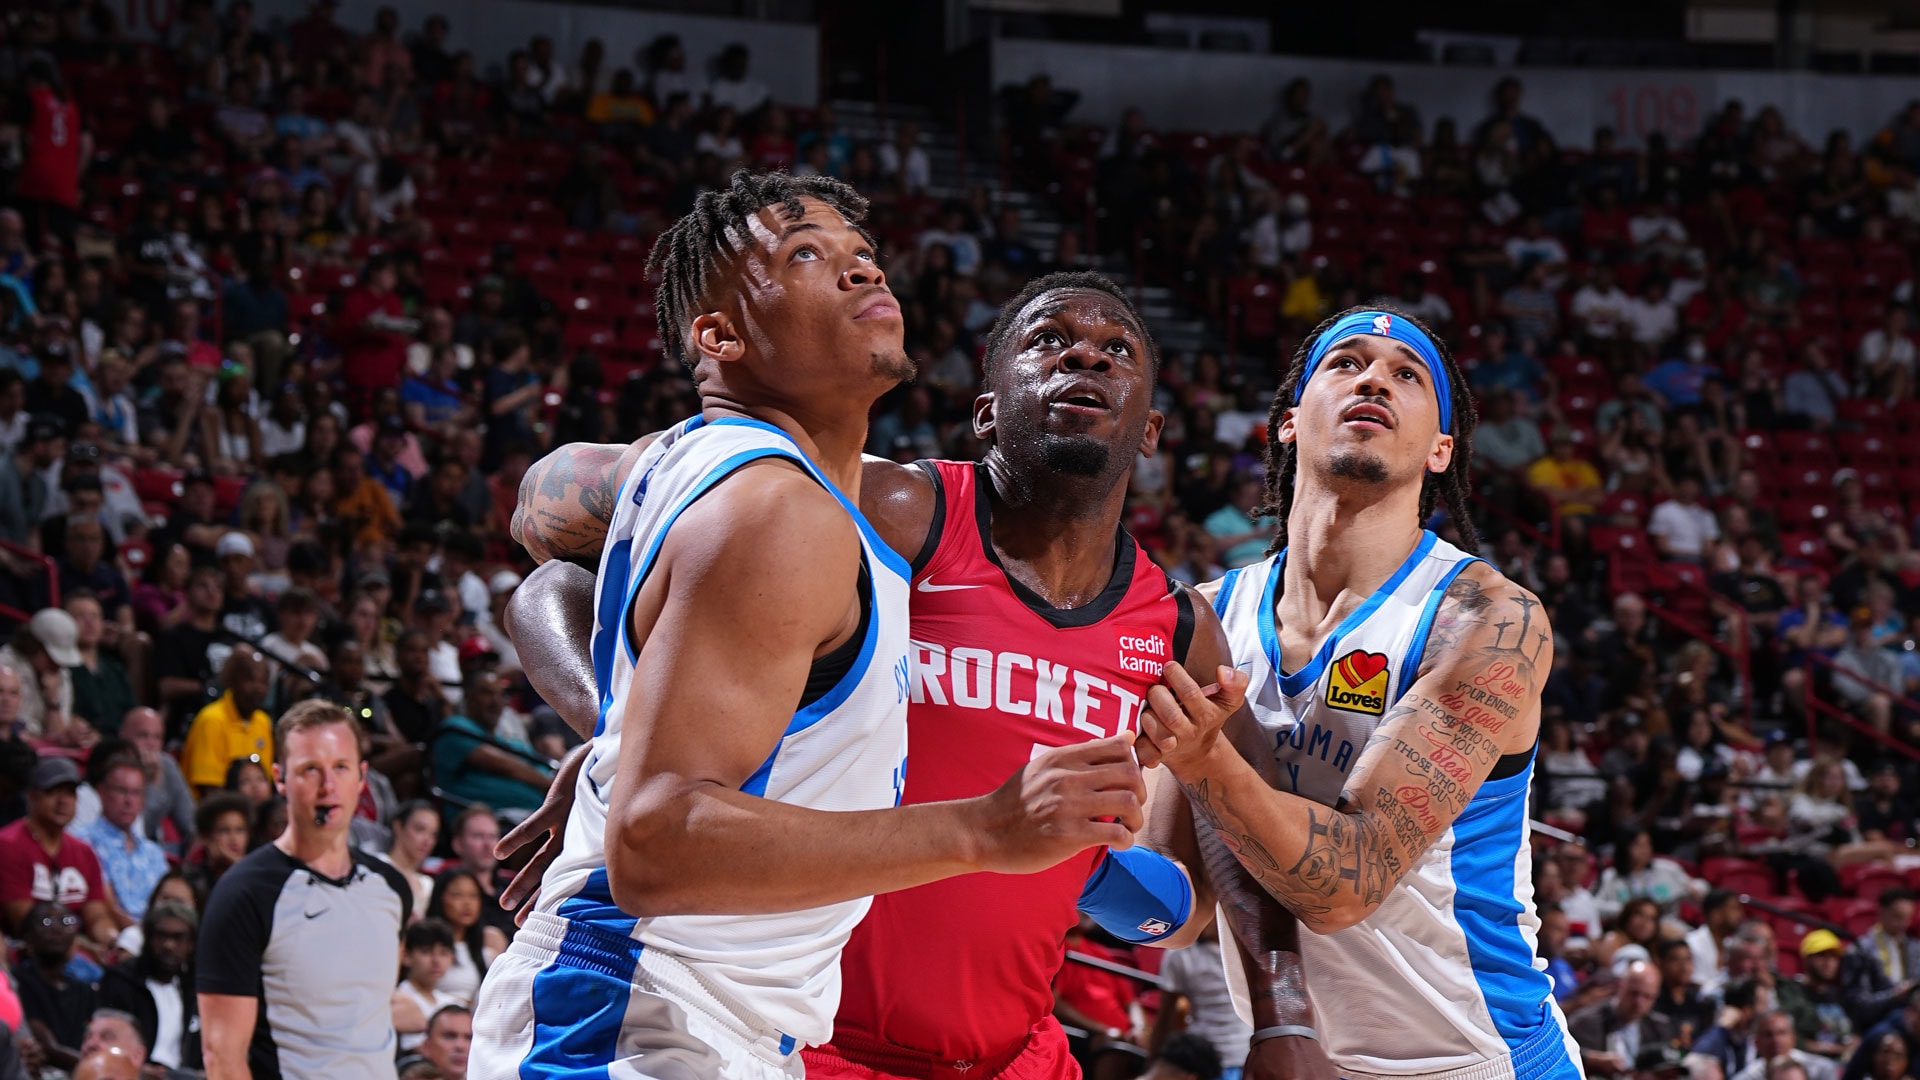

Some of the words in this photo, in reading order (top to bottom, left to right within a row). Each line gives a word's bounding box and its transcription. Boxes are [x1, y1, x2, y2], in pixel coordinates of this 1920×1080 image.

[1606, 85, 1700, 139] 109
[1119, 634, 1165, 656] credit
[1119, 650, 1163, 677] karma
[909, 639, 1146, 739] ROCKET
[1456, 681, 1486, 703] YOUR
[1474, 661, 1525, 699] Love
[1420, 698, 1459, 729] THOSE
[1457, 721, 1483, 745] WHO
[1438, 691, 1466, 712] do
[1454, 706, 1509, 734] good
[1394, 738, 1432, 773] THOSE
[1433, 767, 1456, 794] WHO
[1427, 740, 1472, 783] bless
[1450, 733, 1476, 756] YOU
[1425, 778, 1448, 802] YOU
[1376, 787, 1398, 810] FOR
[1398, 805, 1424, 842] THOSE
[1376, 799, 1412, 848] MISTREAT
